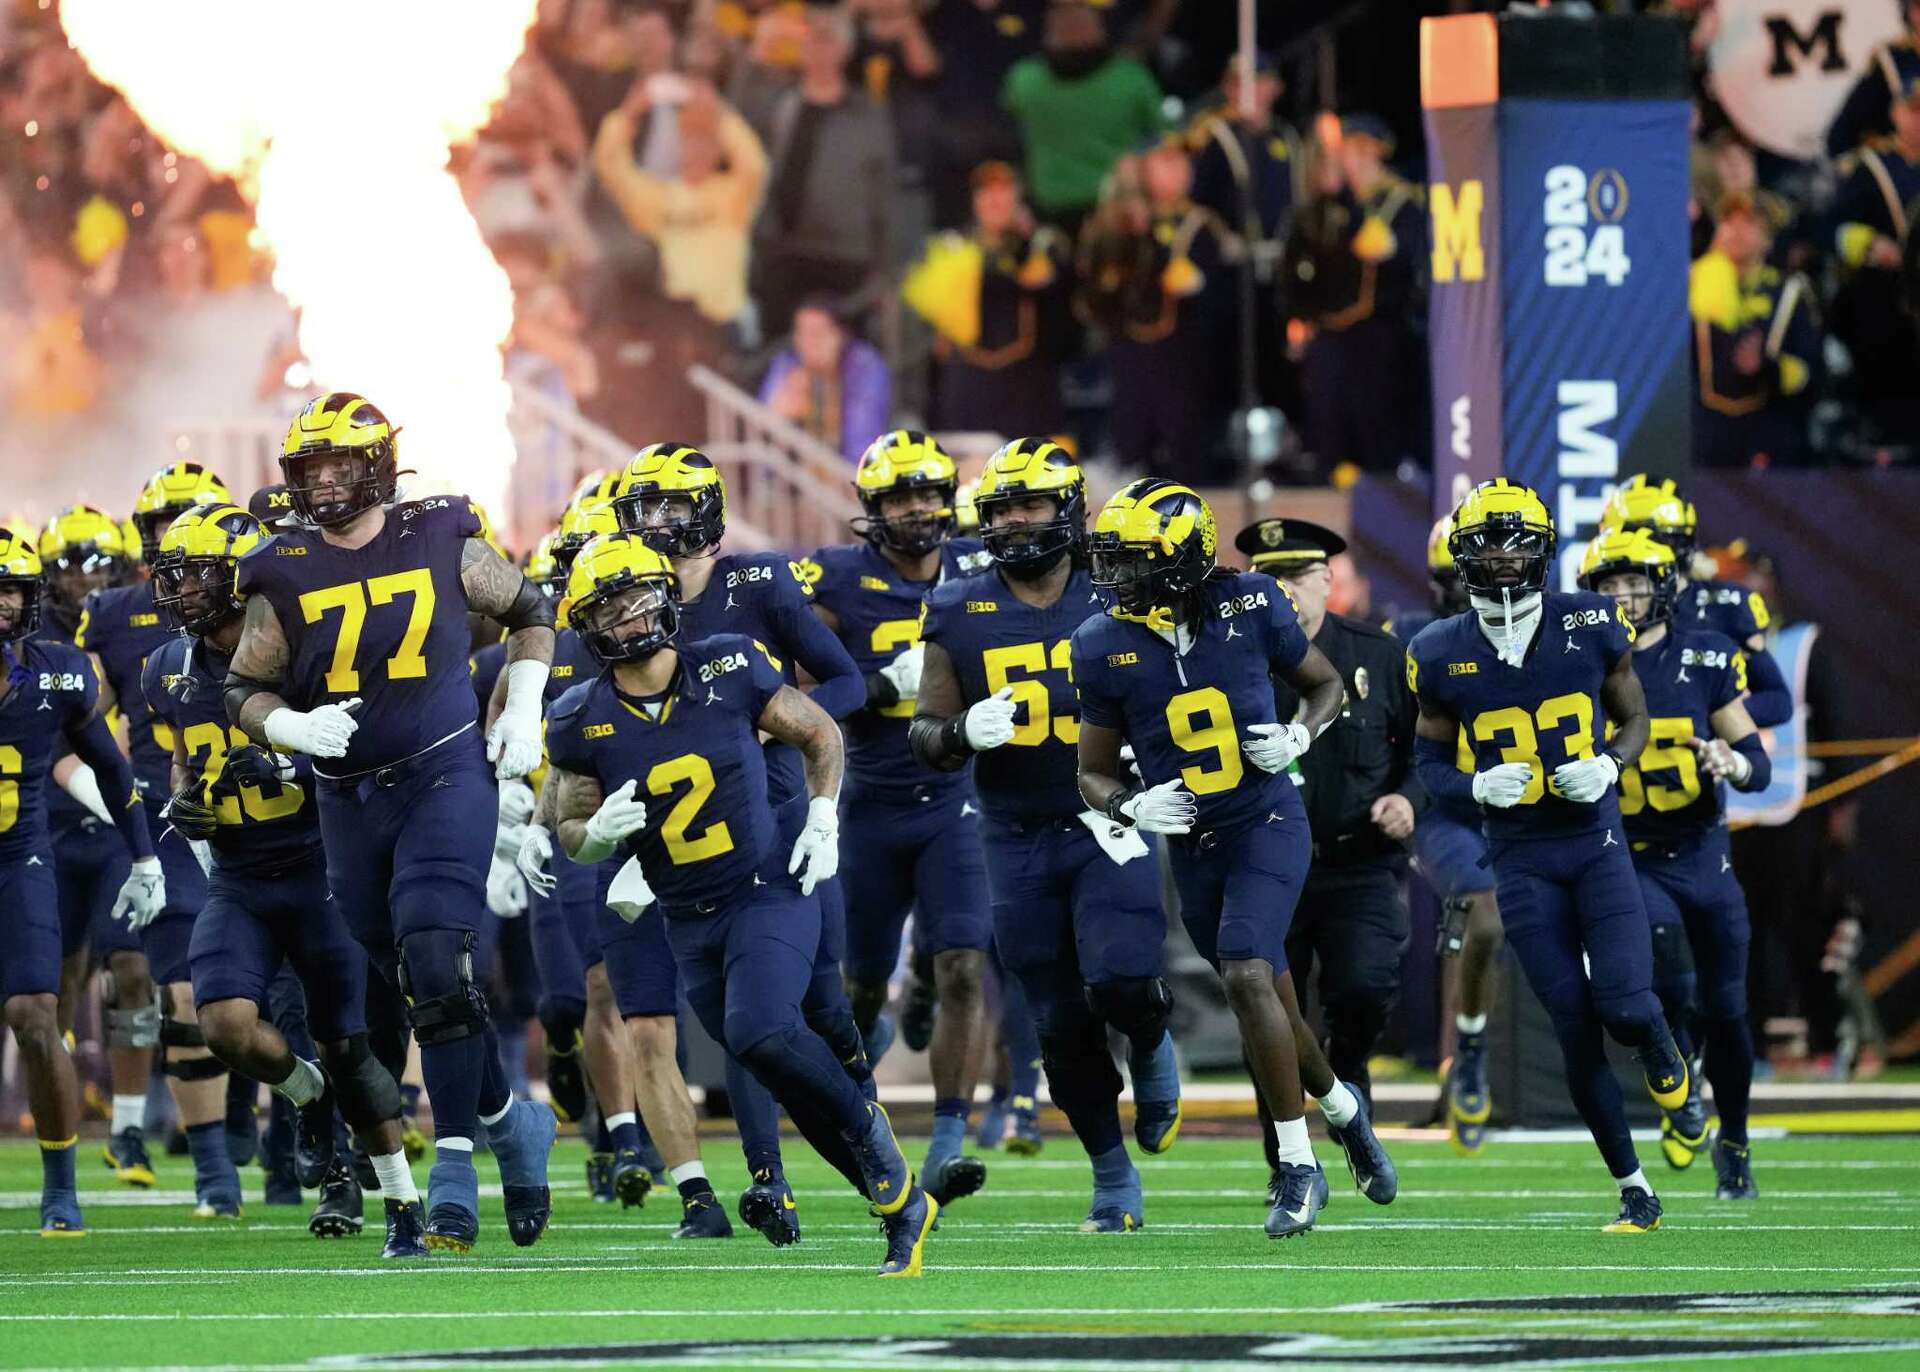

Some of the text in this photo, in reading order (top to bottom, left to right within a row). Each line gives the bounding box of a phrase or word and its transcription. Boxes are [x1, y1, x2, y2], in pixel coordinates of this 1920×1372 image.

[1763, 12, 1848, 75] M
[1430, 179, 1484, 283] M
[268, 492, 291, 508] M
[402, 499, 449, 521] 2024
[726, 566, 773, 588] 2024
[1219, 592, 1269, 619] 2024
[1562, 609, 1610, 631] 2024
[298, 567, 436, 693] 77
[699, 652, 749, 683] 2024
[1681, 648, 1727, 670] 2024
[39, 673, 85, 691] 2024
[1165, 686, 1244, 796] 9
[1473, 691, 1596, 805] 33
[646, 753, 735, 865] 2
